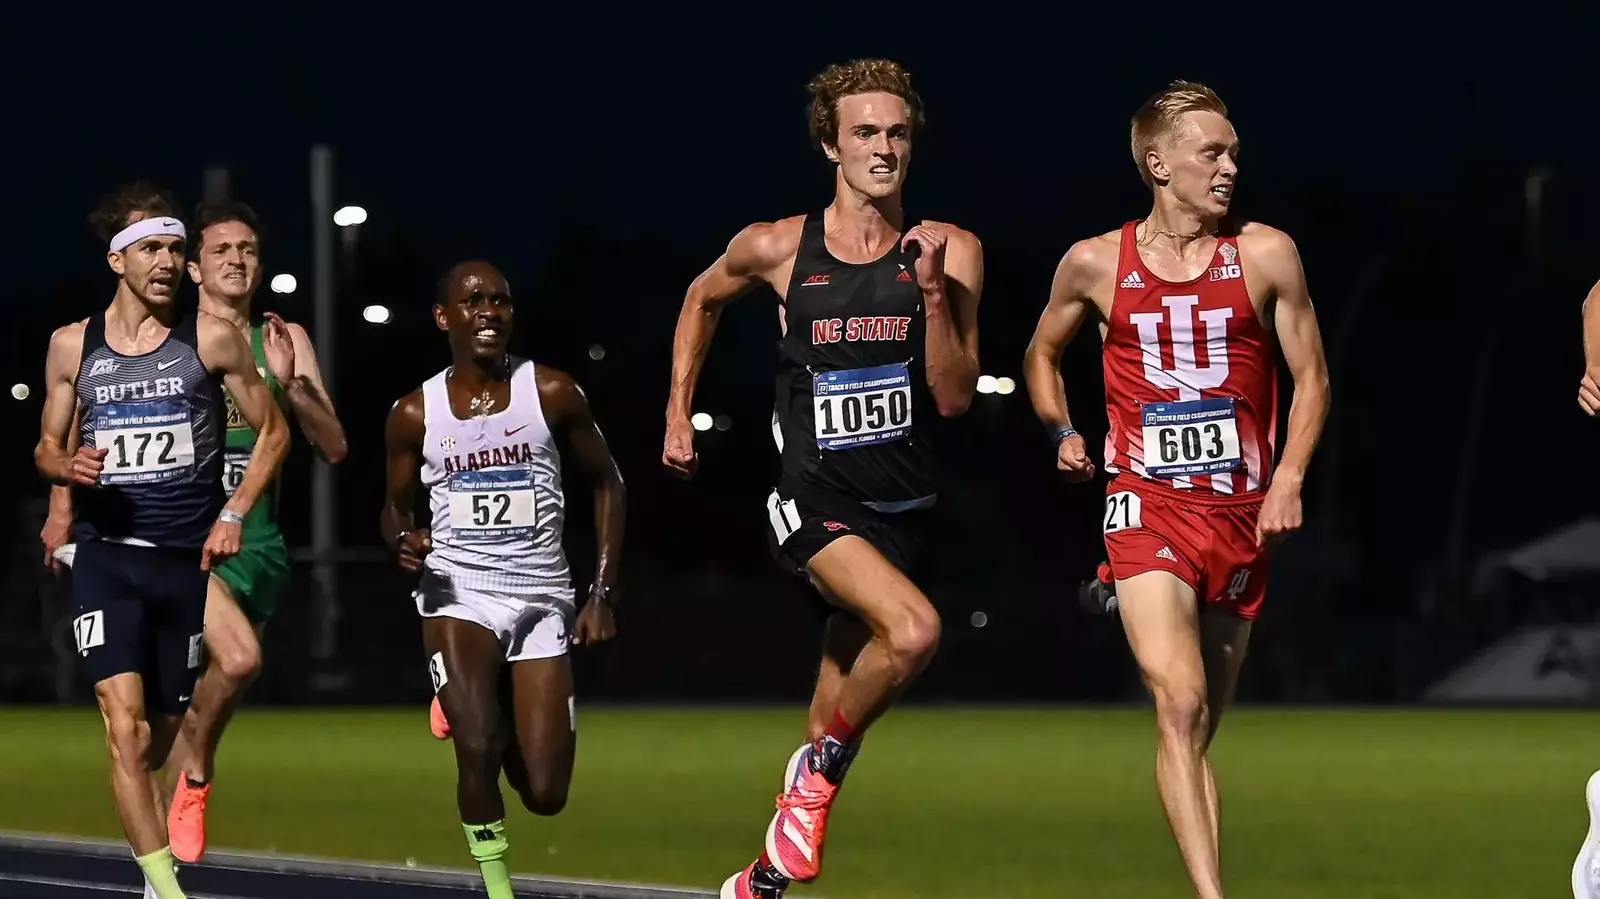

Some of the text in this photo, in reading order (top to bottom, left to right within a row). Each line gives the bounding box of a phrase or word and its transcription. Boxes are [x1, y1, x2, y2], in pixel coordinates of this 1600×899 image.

[804, 275, 830, 284] ACC
[812, 316, 911, 345] NC STATE
[94, 377, 185, 404] BUTLER
[828, 383, 844, 391] TRACK
[849, 382, 863, 390] FIELD
[864, 376, 905, 388] CHAMPIONSHIPS
[108, 417, 124, 426] TRACK
[129, 416, 143, 424] FIELD
[820, 390, 908, 435] 1050
[1177, 413, 1190, 421] FIELD
[1191, 409, 1231, 419] CHAMPIONSHIPS
[113, 431, 177, 468] 172
[443, 442, 533, 475] ALABAMA
[1159, 423, 1224, 463] 603
[472, 493, 512, 526] 52
[1105, 494, 1131, 531] 21
[75, 614, 96, 650] 17
